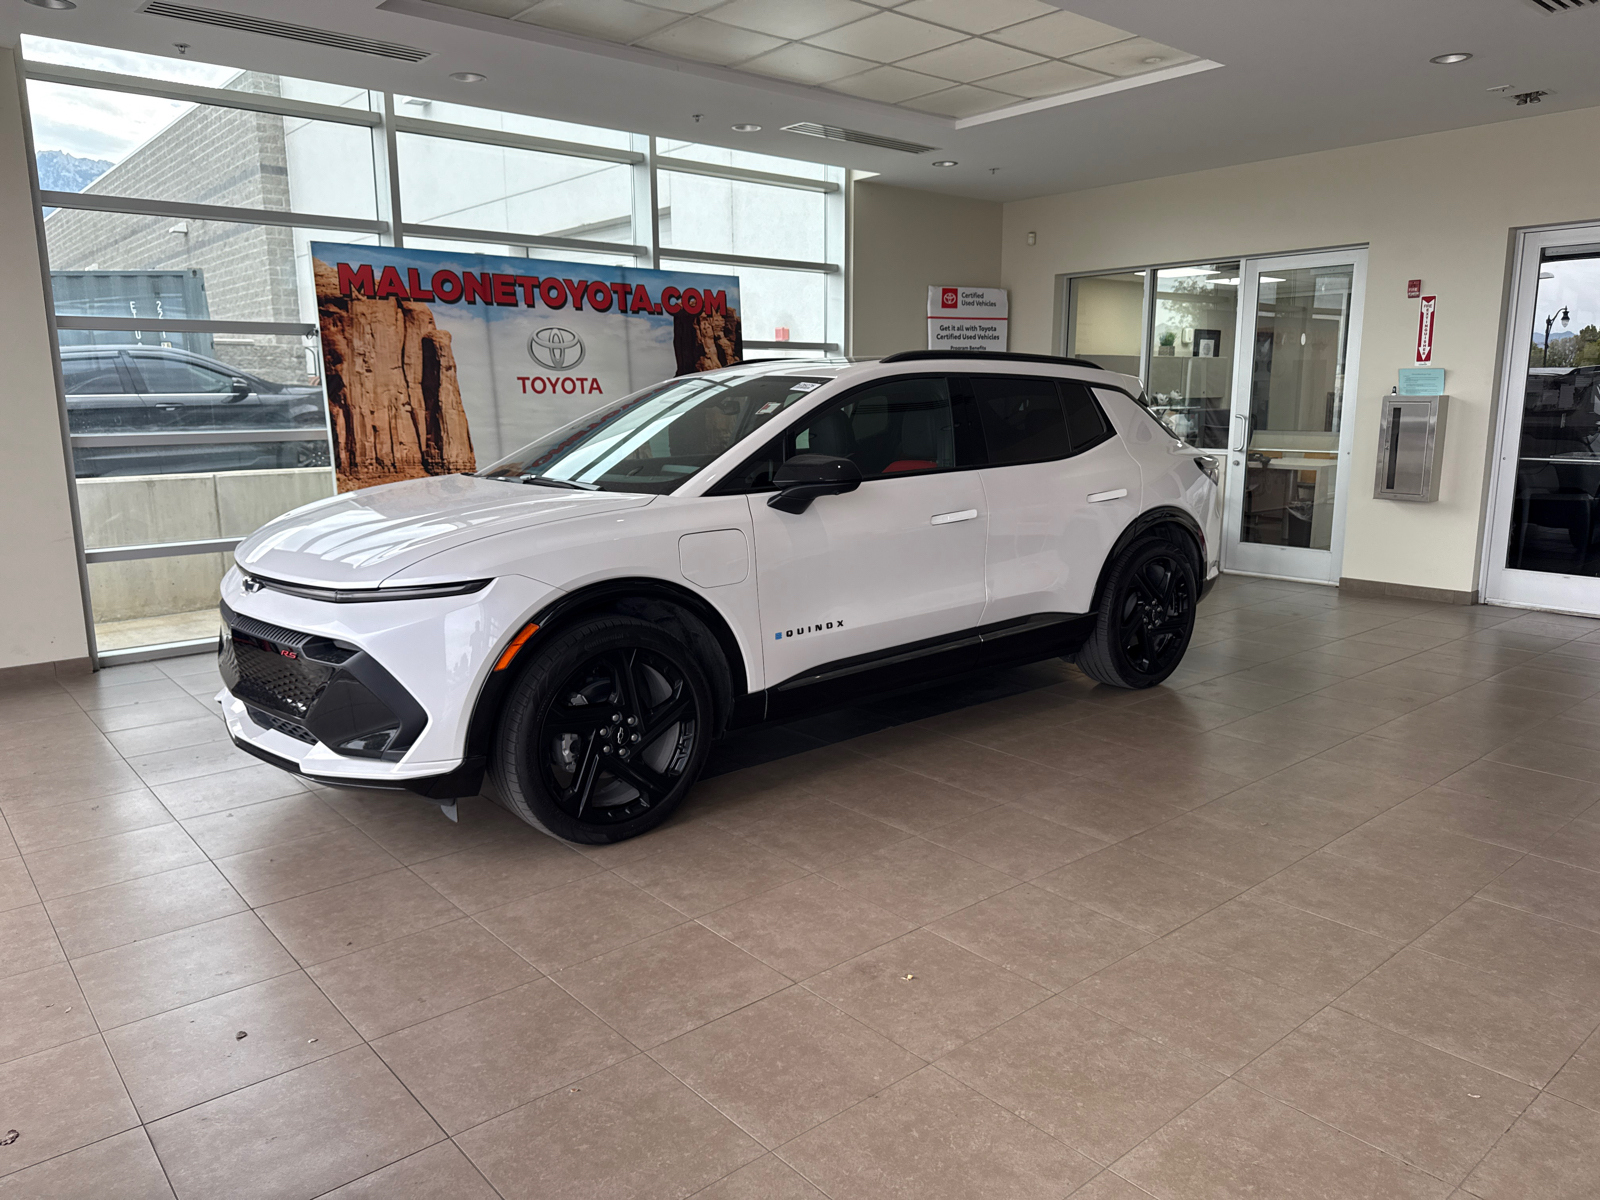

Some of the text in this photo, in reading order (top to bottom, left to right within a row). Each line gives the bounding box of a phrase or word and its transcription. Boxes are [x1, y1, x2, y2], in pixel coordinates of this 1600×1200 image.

[336, 262, 728, 317] MALONETOYOTA.COM
[978, 325, 997, 333] Toyota
[517, 377, 603, 395] TOYOTA
[280, 649, 297, 660] RS
